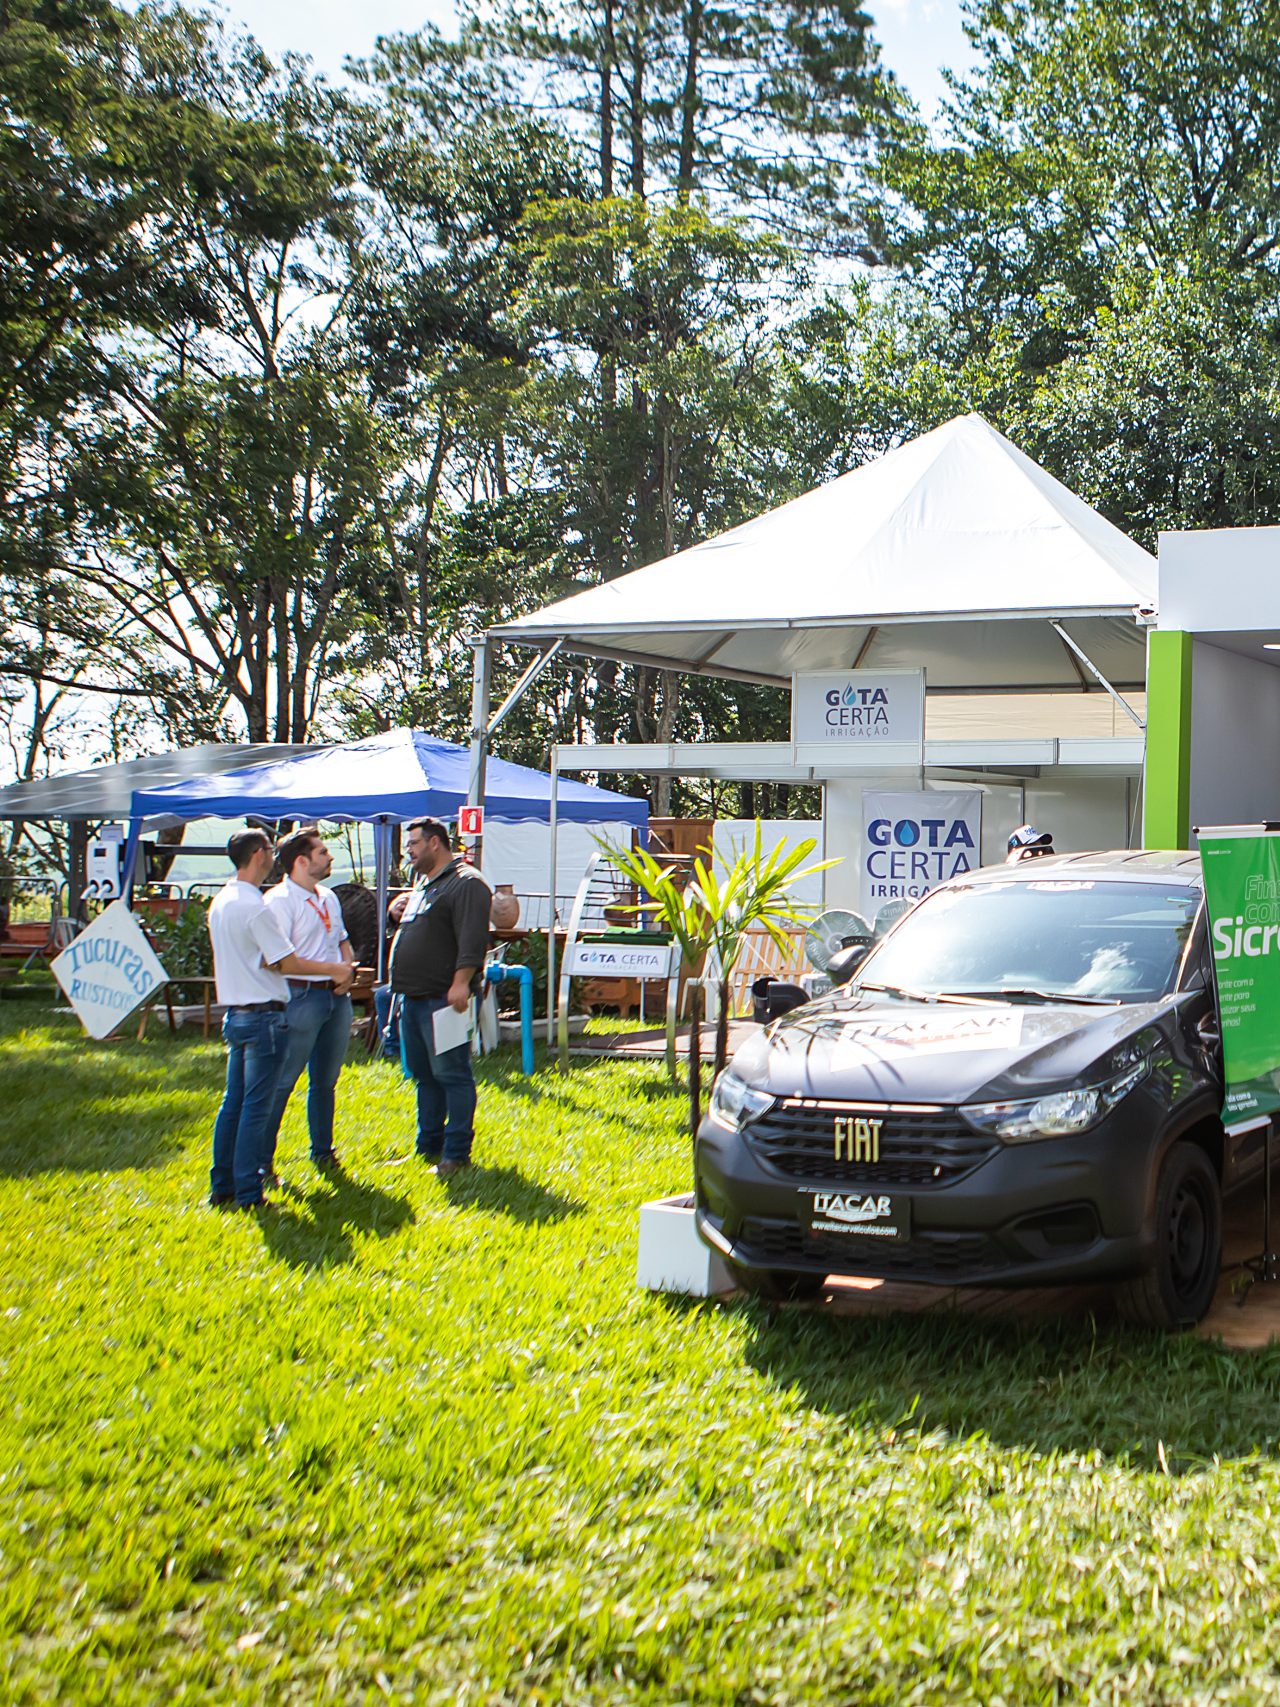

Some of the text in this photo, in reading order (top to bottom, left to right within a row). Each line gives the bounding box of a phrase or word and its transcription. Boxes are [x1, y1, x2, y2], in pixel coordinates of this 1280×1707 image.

[826, 707, 889, 726] CERTA
[825, 726, 889, 738] IRRIGAÇÃO
[867, 819, 975, 848] GOTA
[866, 850, 971, 881] CERTA
[871, 884, 931, 898] IRRIGA
[621, 954, 659, 966] CERTA
[834, 1116, 883, 1163] FIAT
[814, 1193, 892, 1217] ITACAR
